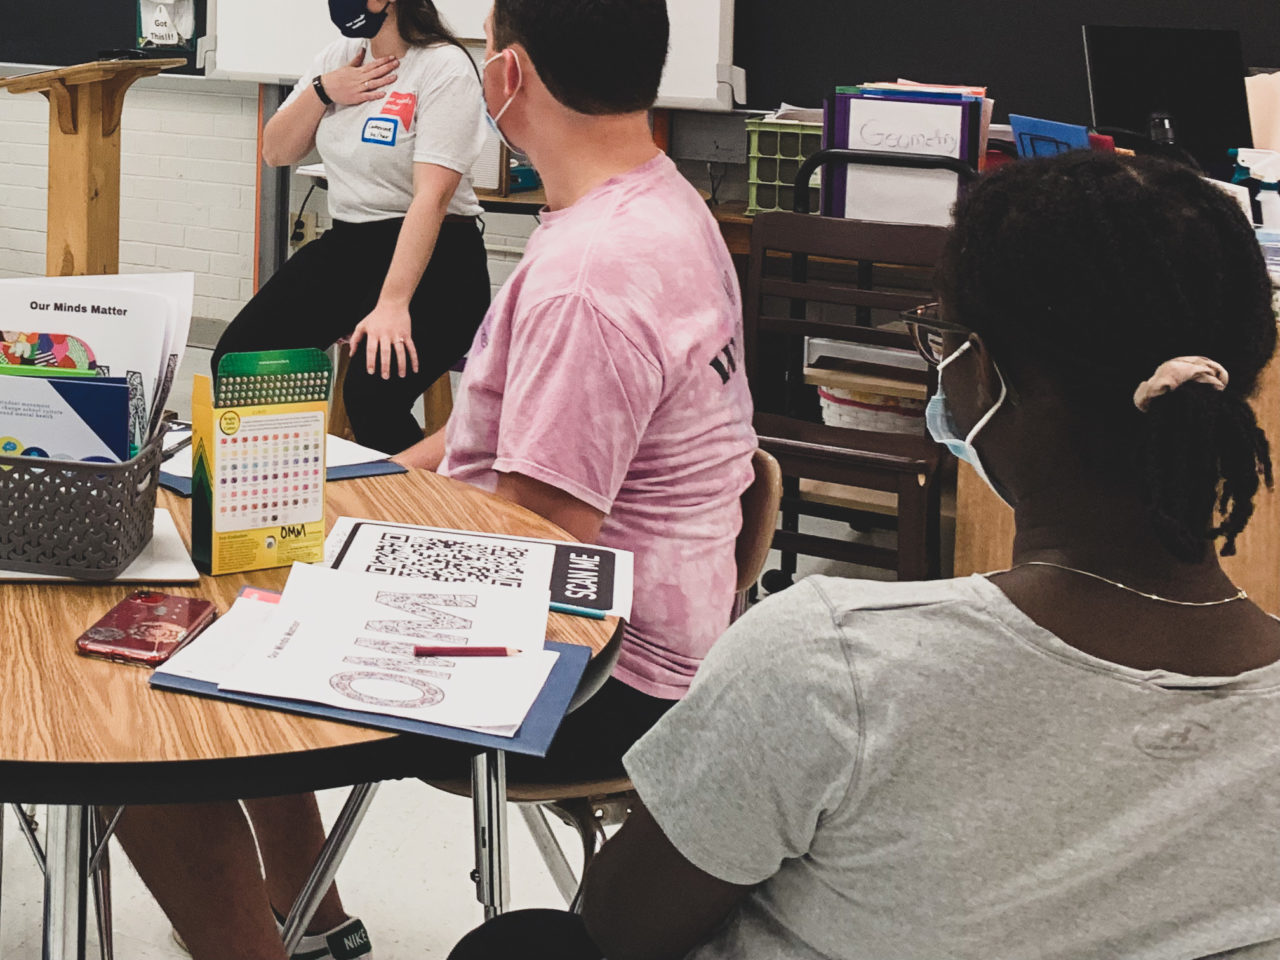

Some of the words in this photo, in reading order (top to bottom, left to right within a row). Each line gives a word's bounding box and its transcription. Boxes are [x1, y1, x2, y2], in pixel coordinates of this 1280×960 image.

[154, 20, 168, 28] Got
[150, 32, 174, 41] This!!!
[30, 301, 50, 310] Our
[54, 302, 88, 313] Minds
[90, 304, 128, 316] Matter
[568, 552, 600, 570] ME
[564, 570, 598, 600] SCAN
[344, 929, 367, 950] NIKE
